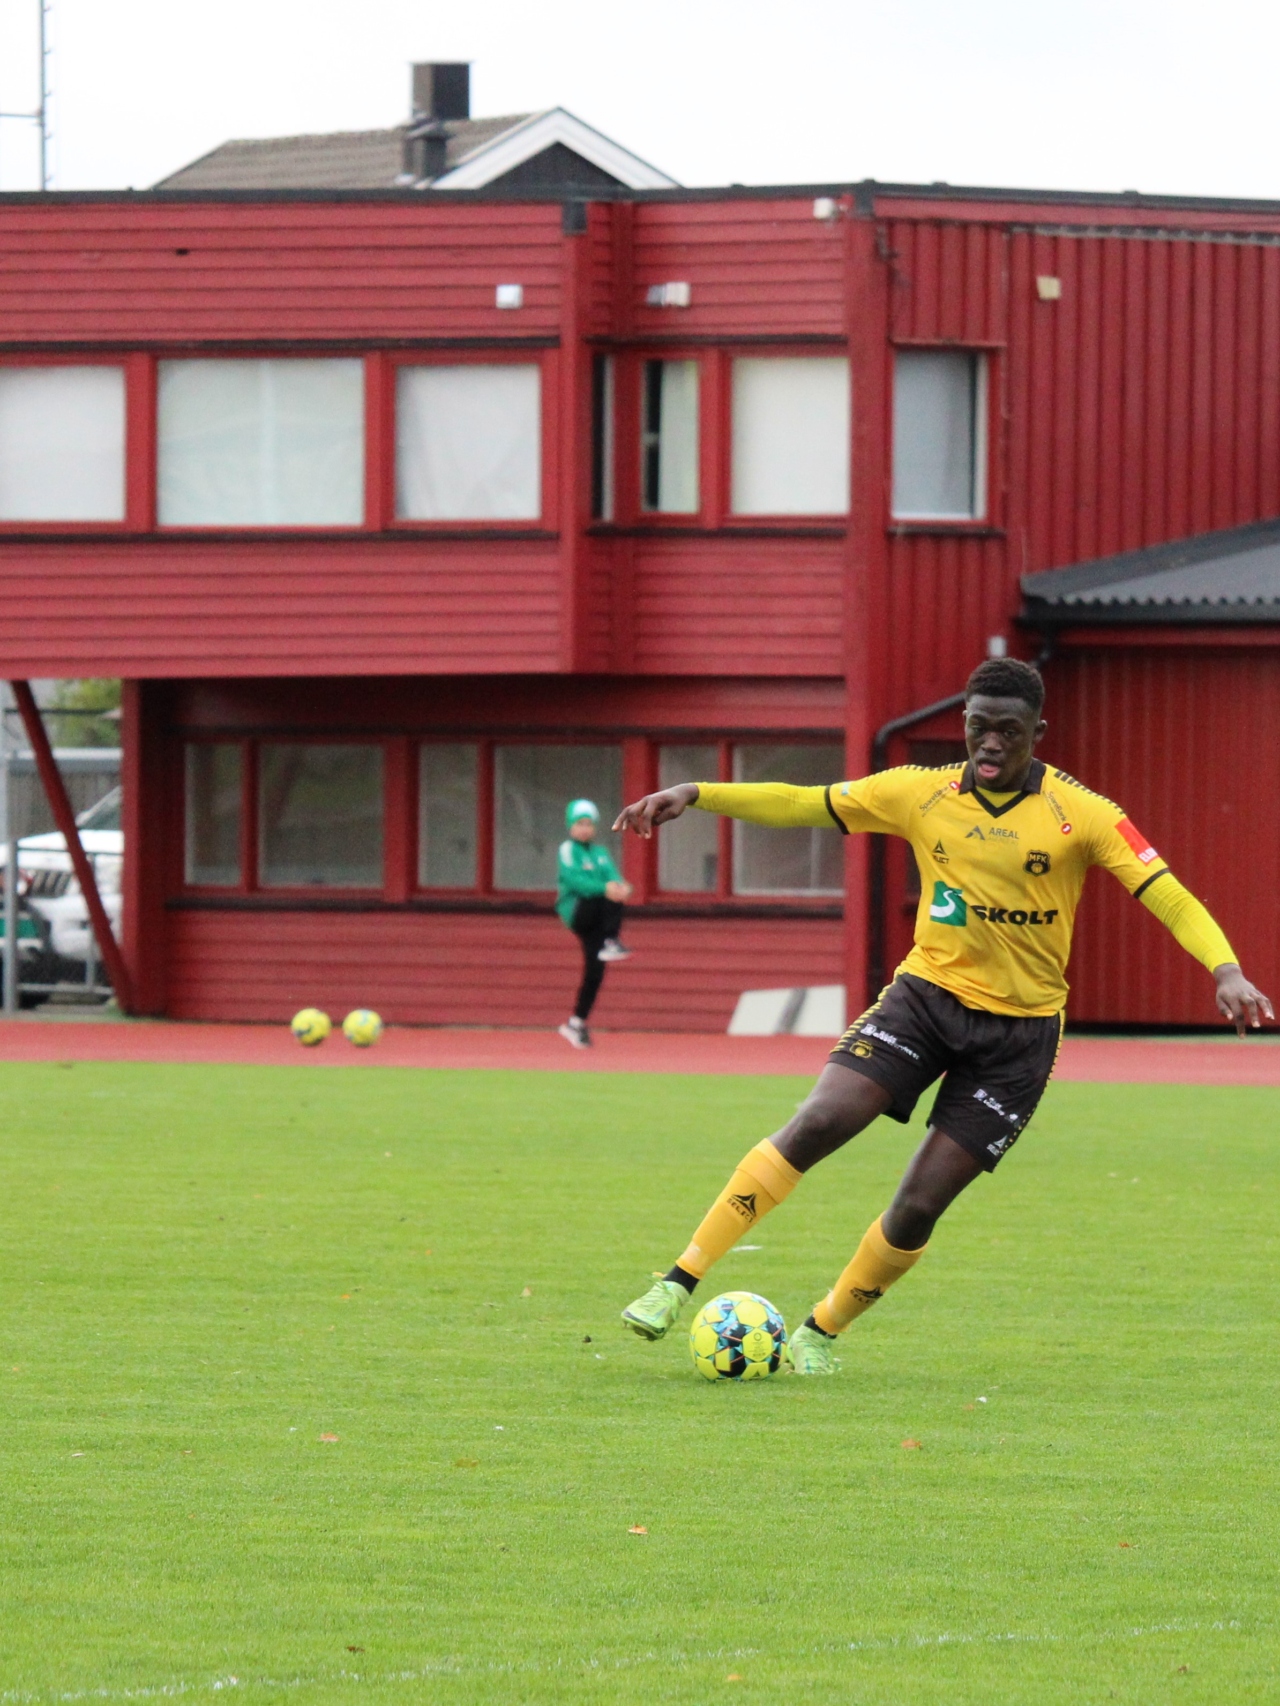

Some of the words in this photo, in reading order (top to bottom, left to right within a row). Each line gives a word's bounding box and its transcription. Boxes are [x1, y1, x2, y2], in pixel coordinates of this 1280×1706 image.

[988, 826, 1020, 840] AREAL
[1028, 852, 1048, 864] MFK
[970, 904, 1059, 926] SKOLT
